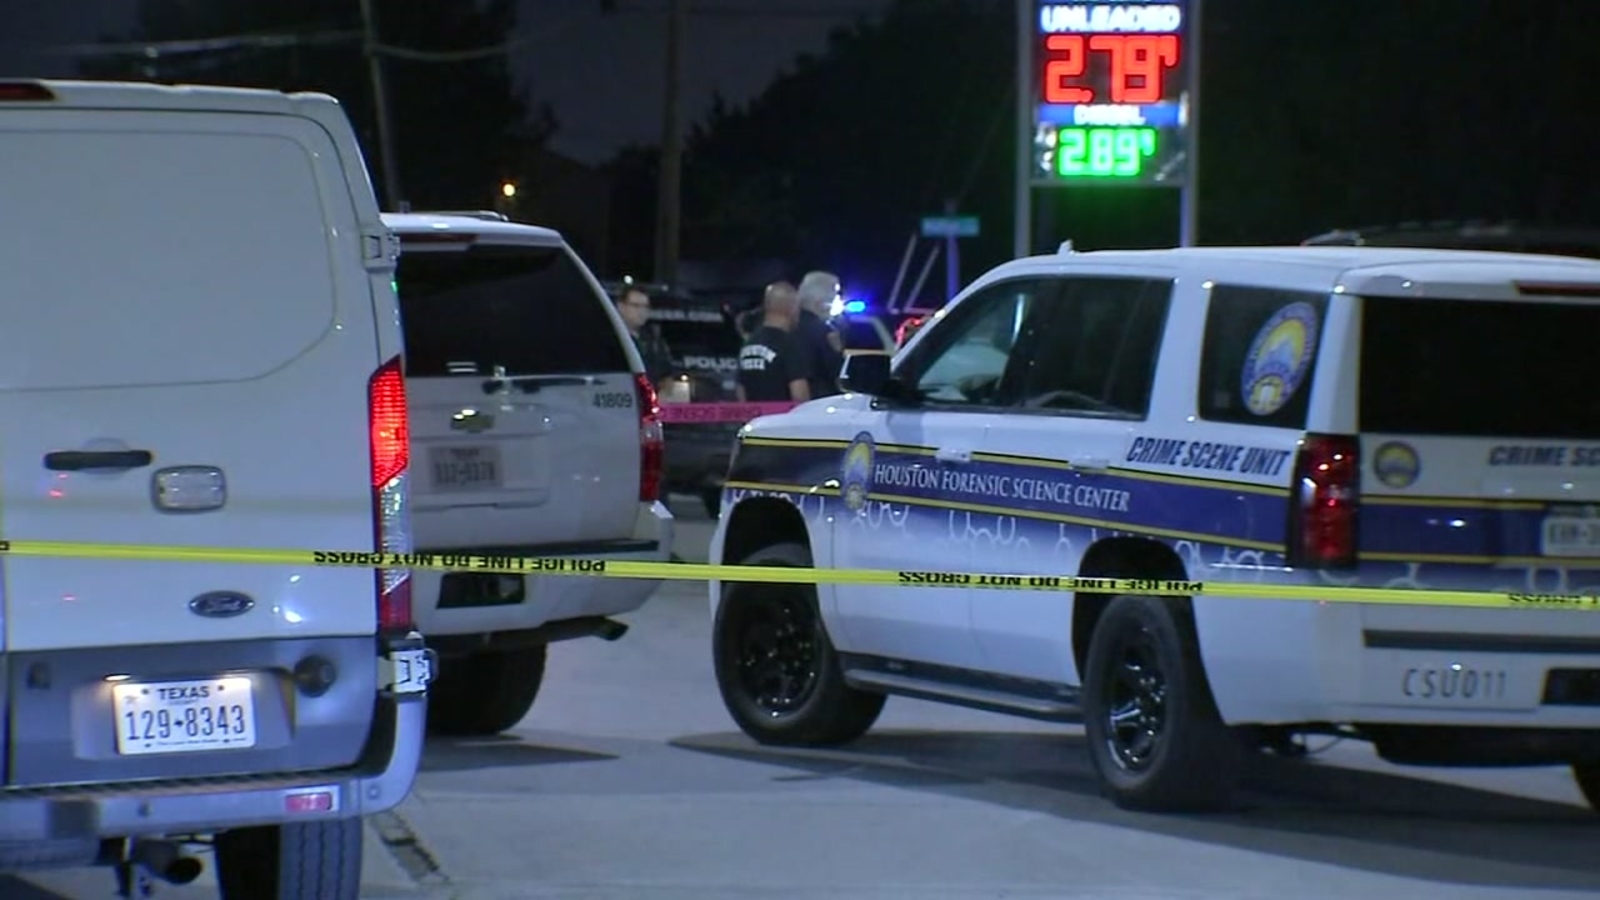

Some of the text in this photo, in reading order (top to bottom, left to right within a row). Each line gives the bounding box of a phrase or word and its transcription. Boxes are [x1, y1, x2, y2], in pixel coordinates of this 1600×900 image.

[684, 356, 738, 370] POLIC
[592, 393, 632, 408] 41809
[1126, 436, 1291, 476] CRIME SCENE UNIT
[1489, 445, 1567, 467] CRIME
[875, 464, 1131, 512] HOUSTON FORENSIC SCIENCE CENTER
[313, 550, 384, 564] CROSS
[532, 558, 606, 572] POLICE
[898, 571, 970, 585] CROSS
[1123, 579, 1204, 592] POLICE
[156, 685, 210, 700] TEXAS
